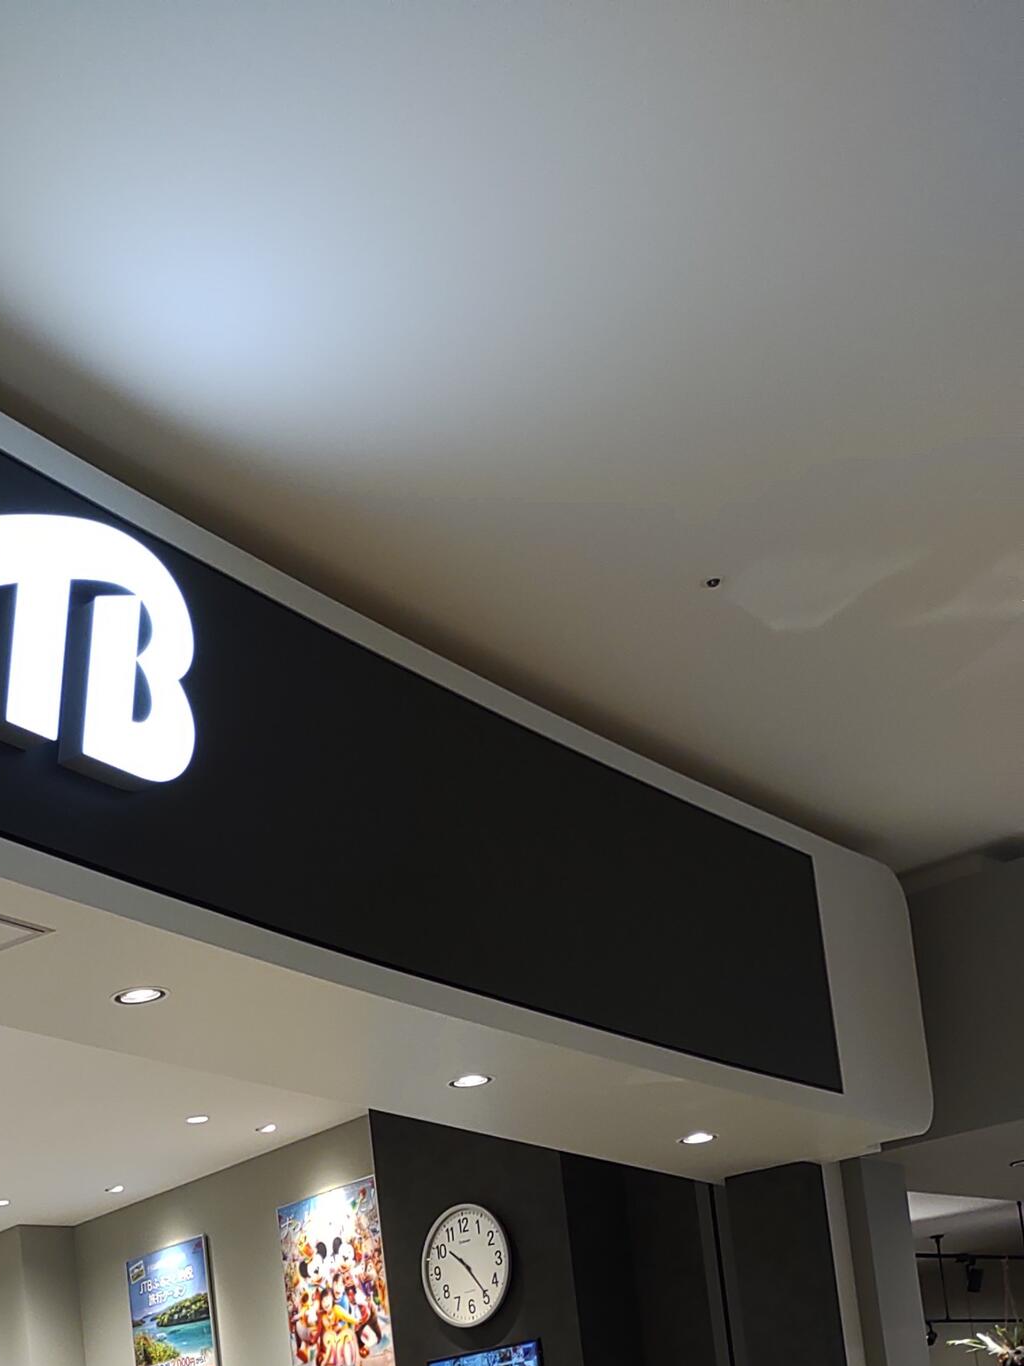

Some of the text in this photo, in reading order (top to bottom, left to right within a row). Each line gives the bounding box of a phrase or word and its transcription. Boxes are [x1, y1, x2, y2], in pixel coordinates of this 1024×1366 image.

[458, 1217, 469, 1233] 12
[476, 1219, 481, 1235] 1
[446, 1226, 455, 1242] 11
[487, 1230, 495, 1246] 2
[436, 1243, 447, 1259] 10
[495, 1250, 503, 1265] 3
[434, 1266, 441, 1280] 9
[491, 1272, 499, 1287] 4
[443, 1284, 450, 1299] 8
[483, 1289, 490, 1305] 5
[454, 1296, 461, 1311] 7
[468, 1299, 476, 1314] 6
